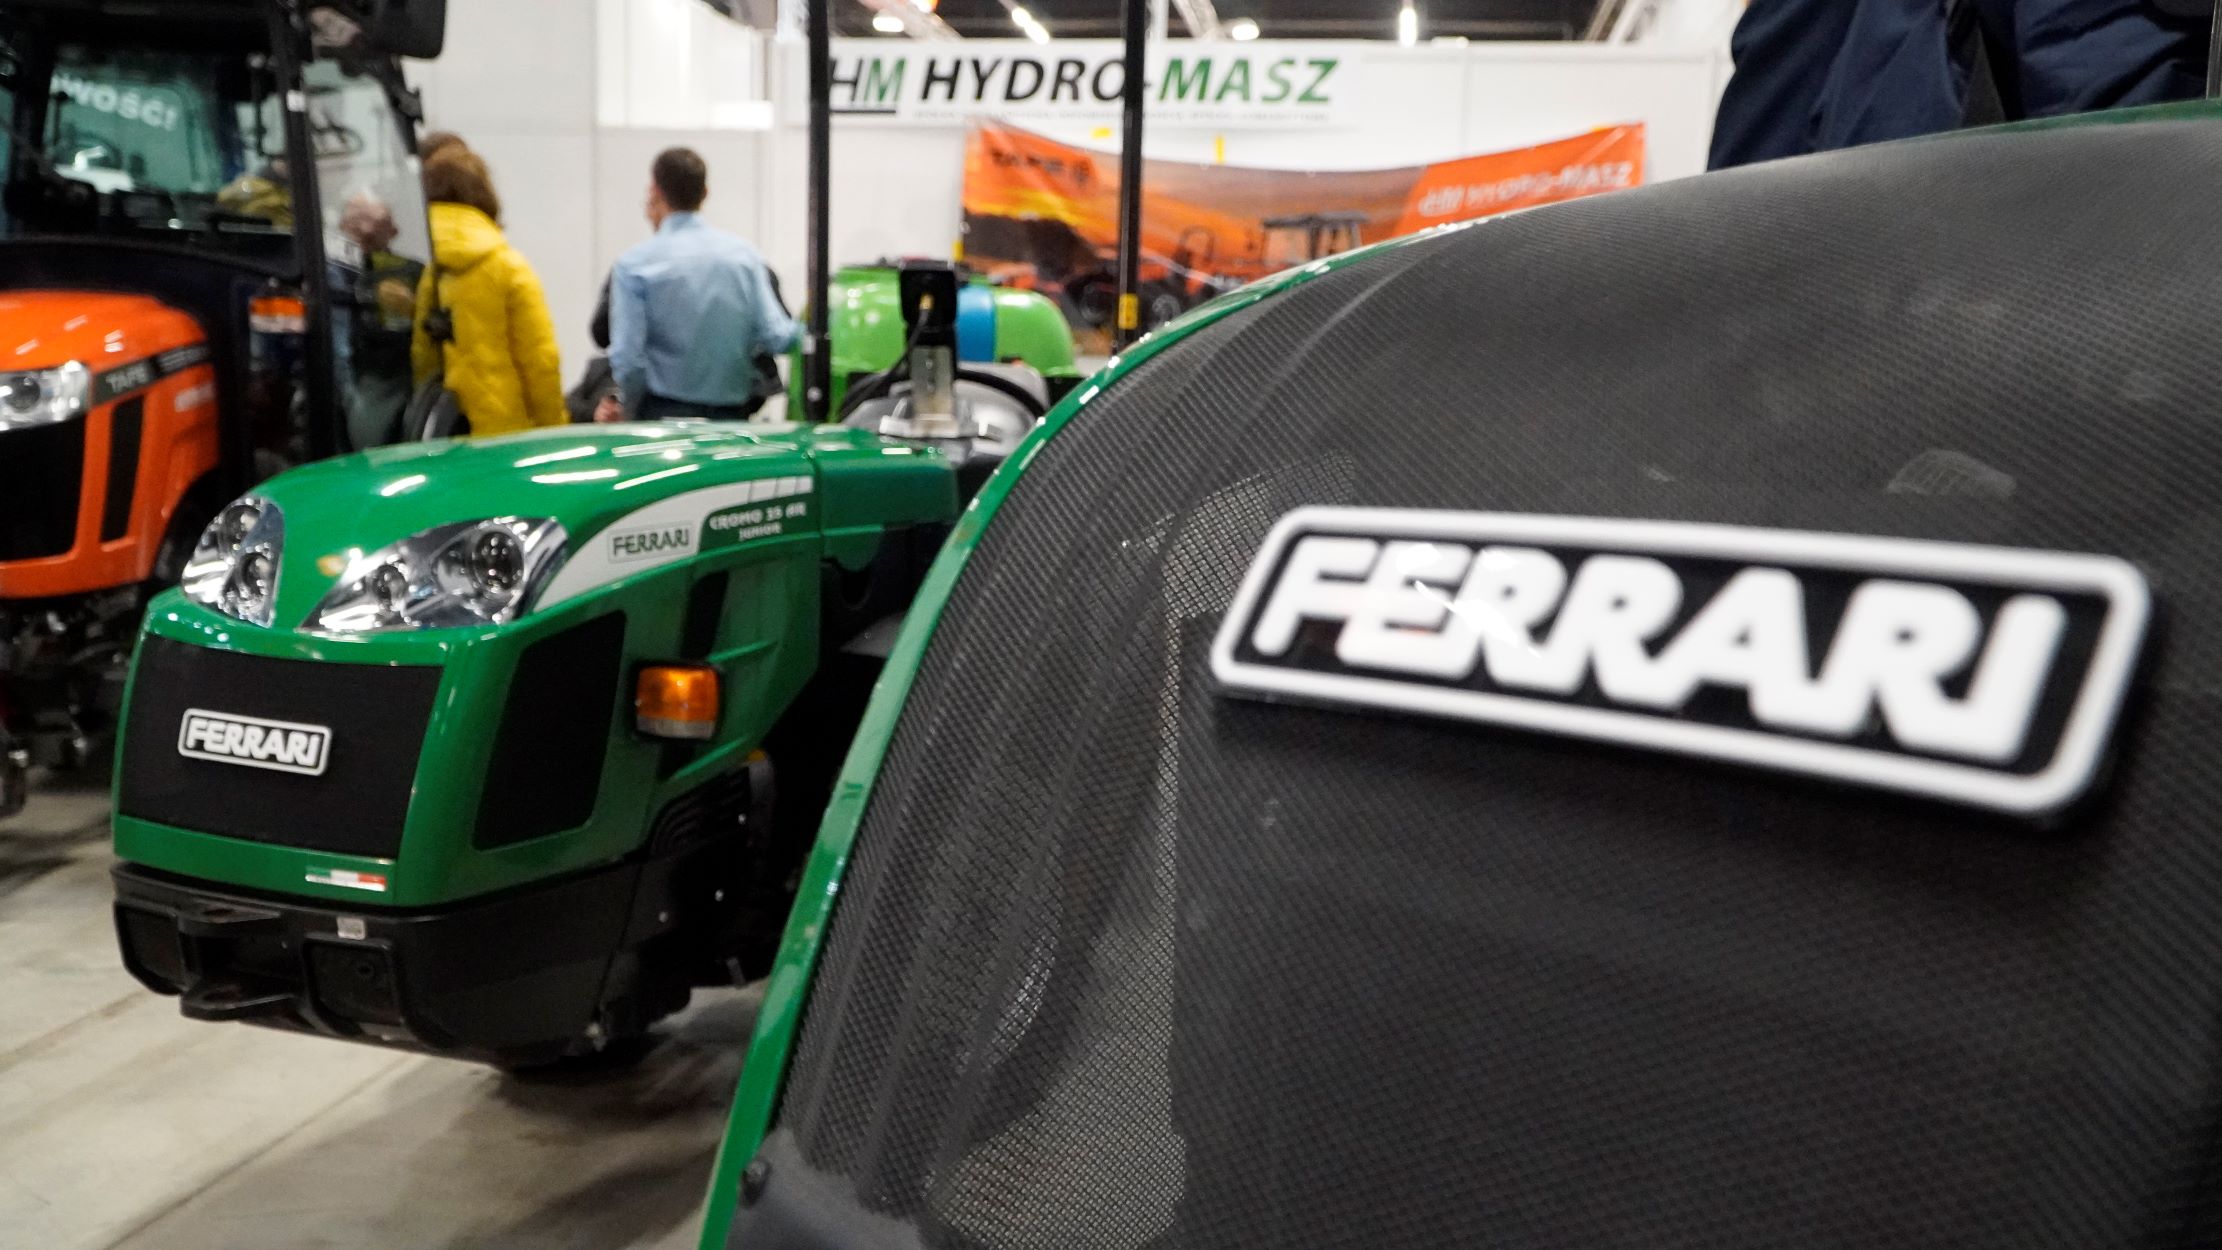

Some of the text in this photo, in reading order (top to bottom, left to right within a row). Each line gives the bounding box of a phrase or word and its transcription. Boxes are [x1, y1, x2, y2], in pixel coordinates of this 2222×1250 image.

[828, 58, 905, 102] HM
[709, 508, 763, 530] CROMO
[739, 521, 782, 542] JUNIOR
[613, 528, 689, 556] FERRARI
[1253, 535, 2068, 762] FERRARI
[186, 716, 320, 767] FERRARI
